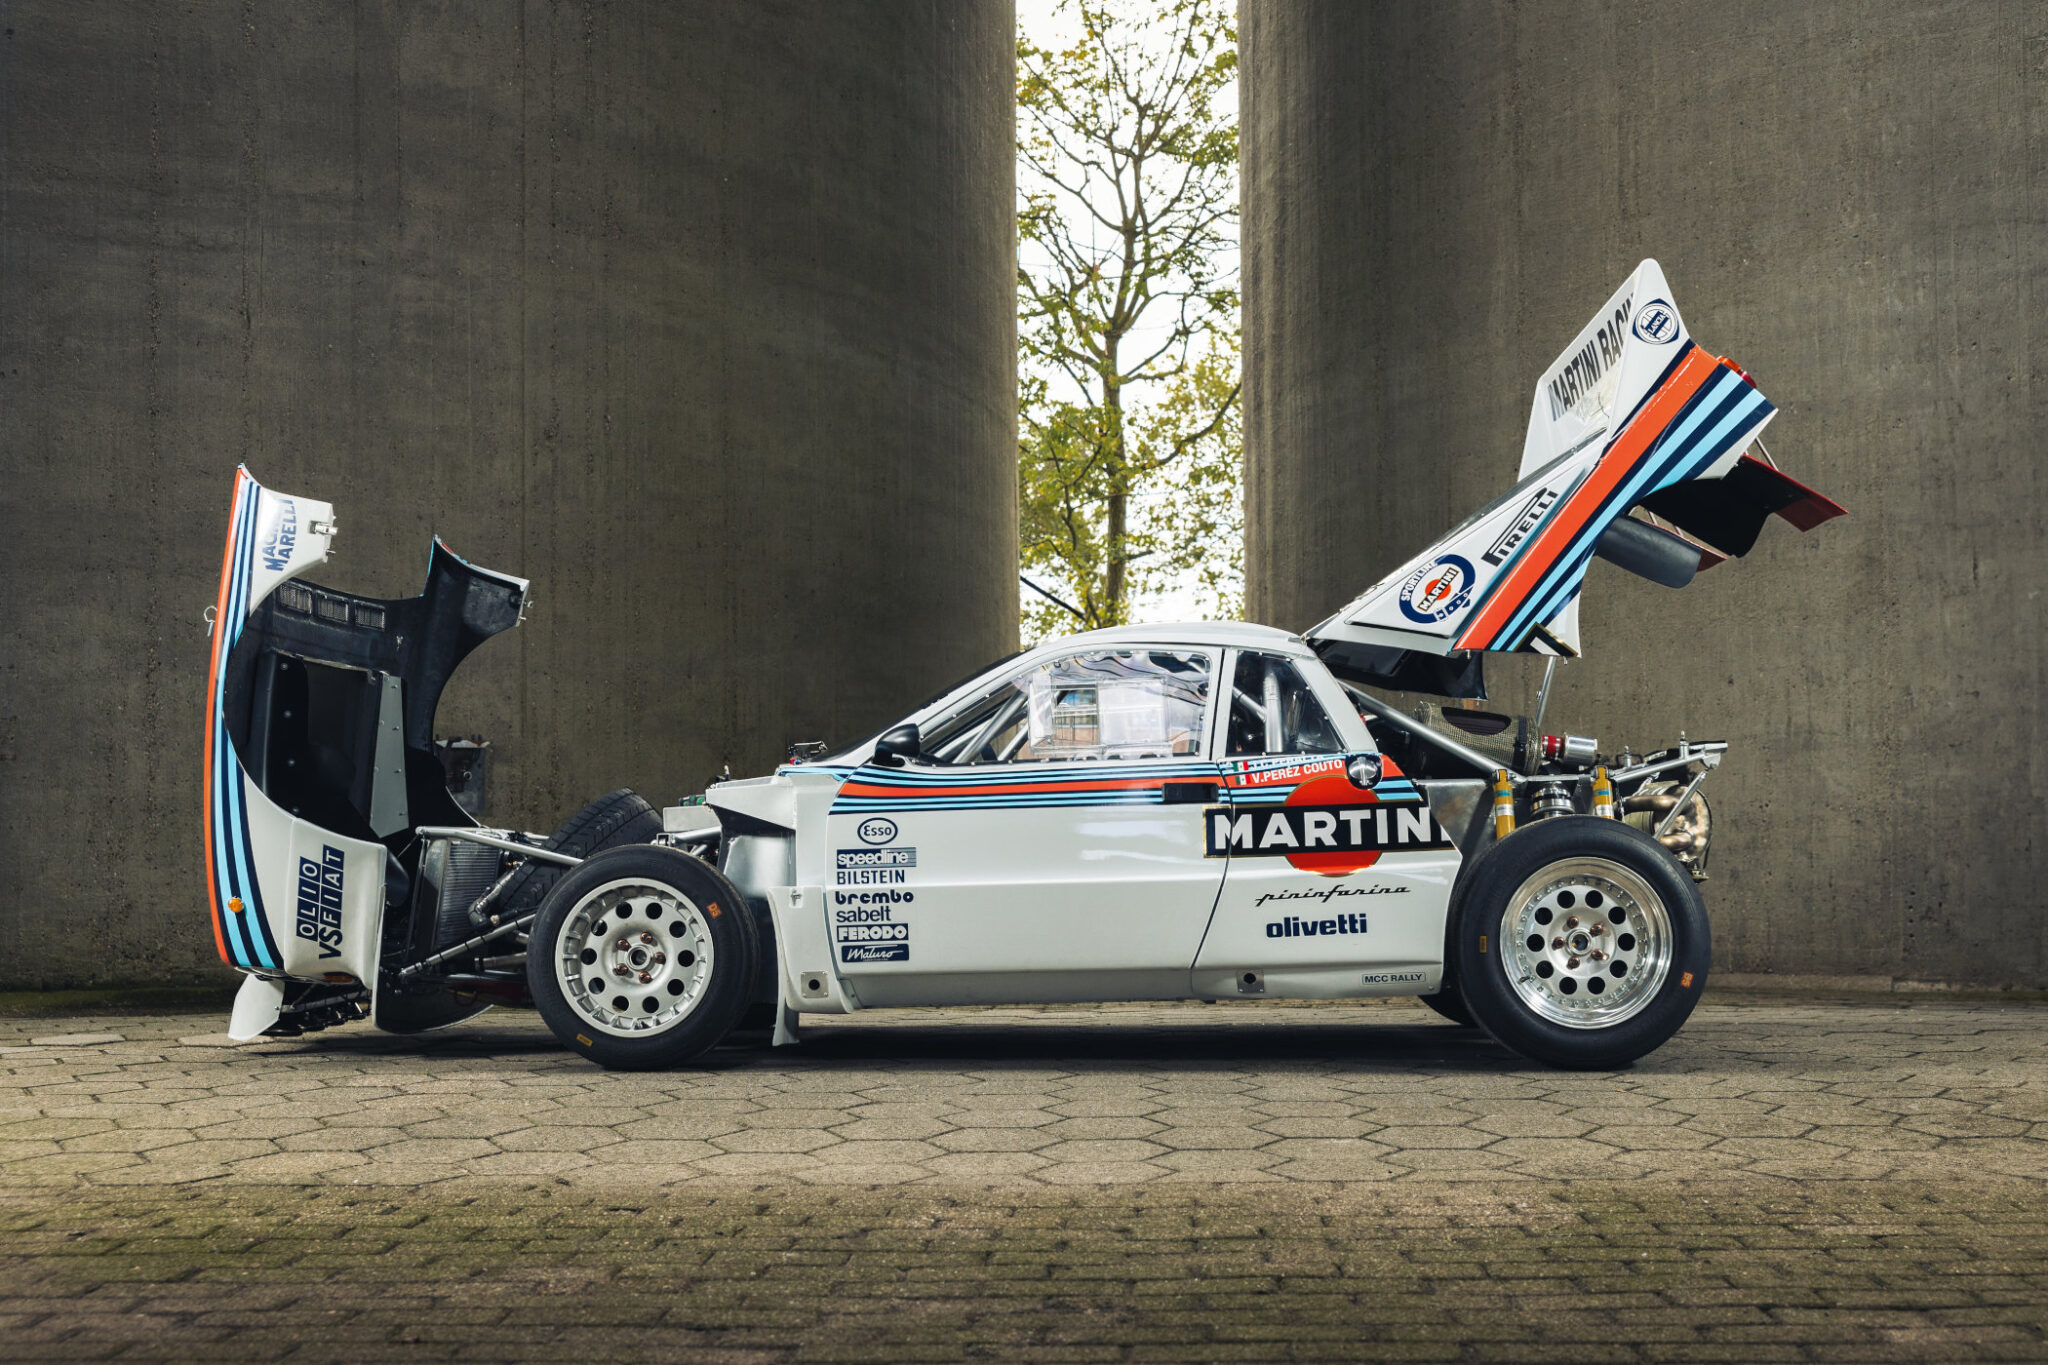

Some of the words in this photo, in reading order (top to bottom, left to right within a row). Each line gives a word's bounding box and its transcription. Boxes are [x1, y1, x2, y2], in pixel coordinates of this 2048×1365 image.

[1547, 340, 1602, 422] MARTINI
[263, 499, 297, 572] MARELLI
[1481, 487, 1559, 567] PIRELLI
[1418, 568, 1458, 611] MARTINI
[1303, 760, 1343, 773] COUTO
[863, 824, 892, 837] Esso
[837, 849, 909, 868] speedline
[322, 849, 342, 925] FIAT
[837, 870, 906, 885] BILSTEIN
[299, 862, 319, 938] OLIO
[835, 889, 914, 905] brembo
[1255, 884, 1411, 907] pininfarina
[836, 905, 892, 923] sabelt
[838, 925, 907, 941] FERODO
[1266, 913, 1368, 938] olivetti
[847, 944, 904, 961] Maturo
[1364, 974, 1388, 984] MCC
[1391, 973, 1423, 983] RALLY
